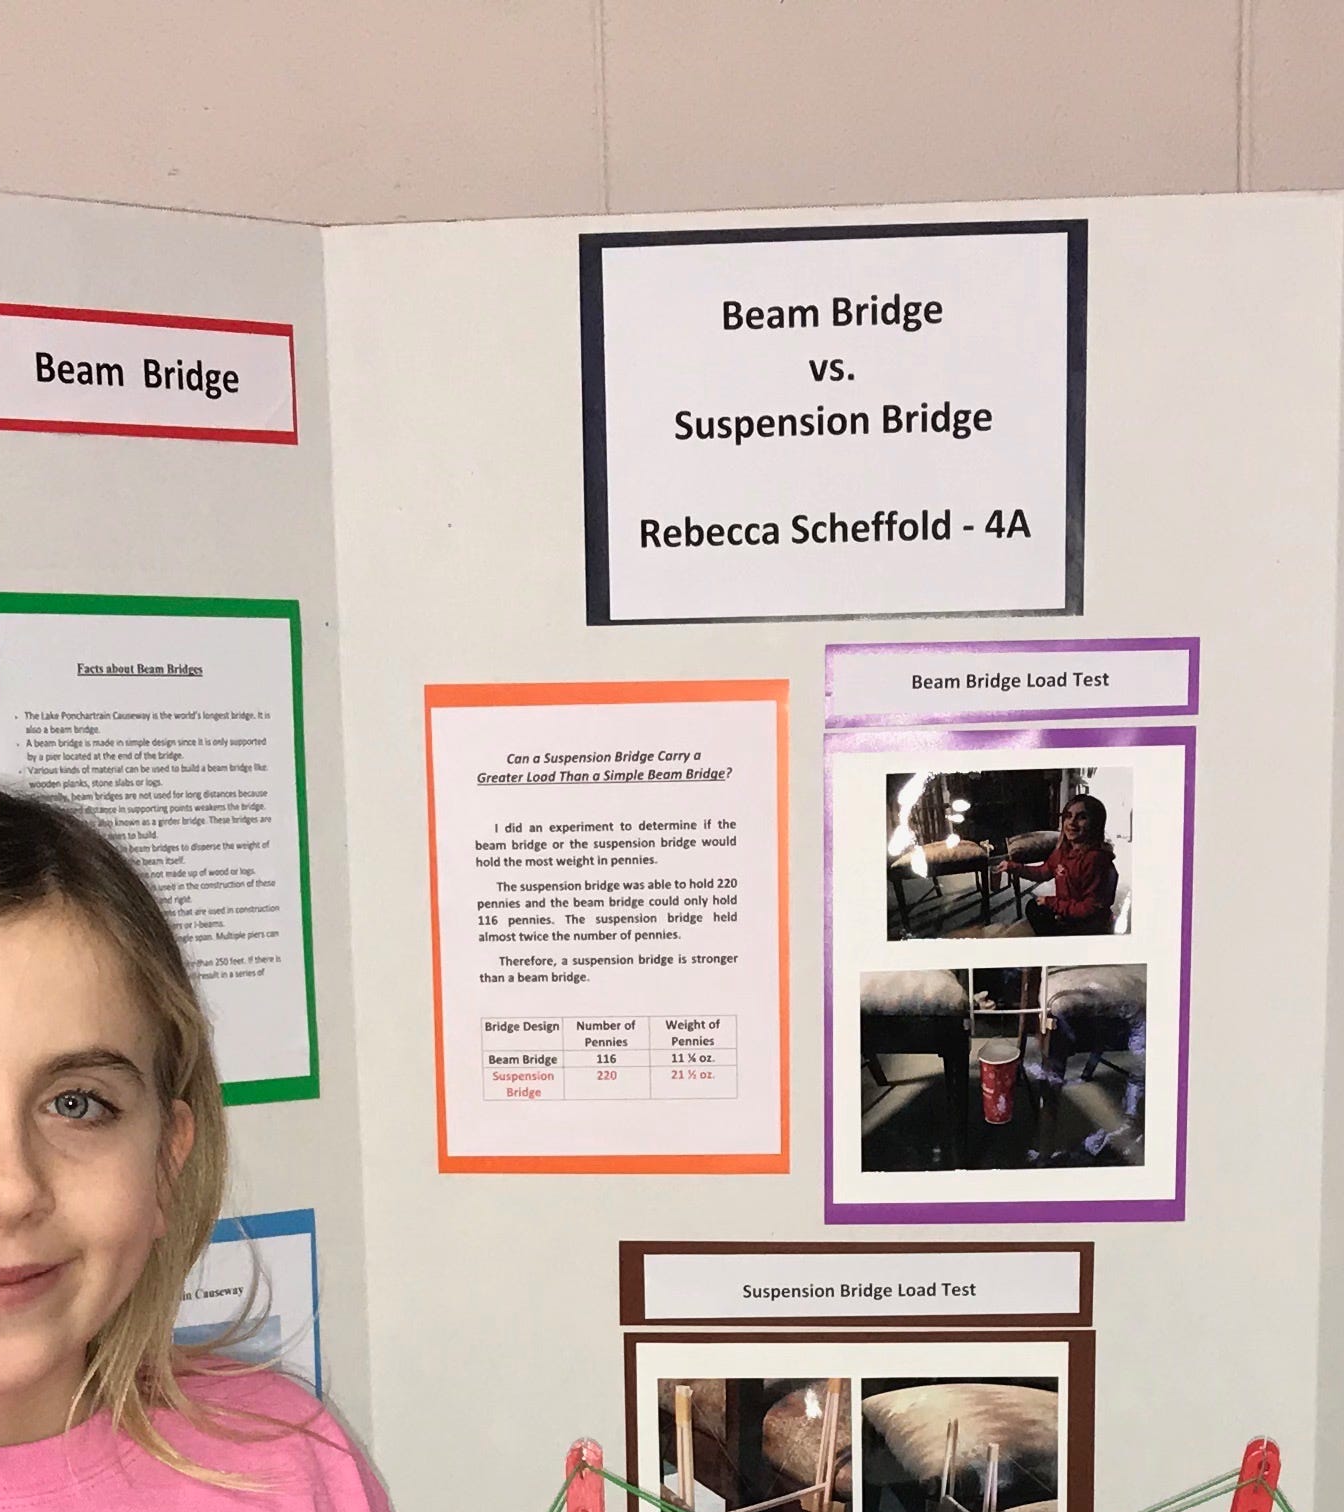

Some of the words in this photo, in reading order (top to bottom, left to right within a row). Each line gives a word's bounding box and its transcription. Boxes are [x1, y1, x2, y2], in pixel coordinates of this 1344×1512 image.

[723, 300, 818, 330] Beam
[832, 293, 942, 331] Bridge
[35, 351, 123, 386] Beam
[143, 358, 238, 399] Bridge
[808, 358, 854, 381] vs.
[675, 405, 868, 445] Suspension
[882, 401, 992, 439] Bridge
[640, 516, 779, 548] Rebecca
[791, 509, 950, 544] Scheffold
[985, 509, 1030, 538] 4A
[77, 663, 103, 674] Facts
[106, 664, 134, 674] about
[137, 664, 164, 674] Beam
[167, 664, 203, 676] Bridges
[912, 674, 959, 689] Beam
[966, 672, 1020, 691] Bridge
[1027, 671, 1066, 687] Load
[1072, 672, 1108, 686] Test
[506, 753, 529, 764] Can
[532, 755, 540, 763] a
[543, 751, 611, 765] Suspension
[614, 750, 654, 764] Bridge
[657, 750, 690, 763] Carry
[693, 752, 701, 760] a
[477, 772, 522, 783] Greater
[527, 772, 556, 782] Load
[560, 771, 588, 782] Than
[593, 774, 600, 782] a
[604, 770, 644, 782] Simple
[648, 769, 682, 780] Beam
[686, 767, 732, 782] Bridge?
[504, 822, 522, 833] did
[529, 824, 542, 832] an
[549, 821, 613, 834] experiment
[619, 822, 632, 831] to
[638, 819, 697, 830] determine
[703, 818, 711, 829] if
[717, 818, 736, 829] the
[475, 840, 506, 850] beam
[511, 839, 547, 852] bridge
[552, 841, 564, 849] or
[569, 838, 588, 848] the
[593, 837, 655, 850] suspension
[660, 836, 696, 849] bridge
[701, 835, 736, 846] would
[475, 856, 500, 867] hold
[503, 856, 522, 866] the
[525, 857, 553, 866] most
[555, 855, 594, 868] weight
[597, 855, 607, 865] in
[610, 855, 657, 867] pennies.
[496, 881, 517, 891] The
[519, 881, 581, 893] suspension
[584, 880, 619, 892] bridge
[622, 881, 644, 889] was
[647, 879, 671, 889] able
[674, 879, 686, 889] to
[689, 878, 713, 888] hold
[717, 878, 737, 888] 220
[478, 915, 498, 925] 116
[508, 914, 554, 927] pennies.
[564, 913, 585, 924] The
[595, 912, 657, 925] suspension
[667, 911, 702, 924] bridge
[713, 911, 737, 921] held
[499, 955, 556, 966] Therefore,
[561, 957, 567, 965] a
[572, 954, 633, 967] suspension
[638, 953, 673, 966] bridge
[678, 953, 687, 963] is
[691, 954, 738, 965] stronger
[484, 1021, 519, 1033] Bridge
[522, 1020, 559, 1033] Design
[576, 1020, 620, 1030] Number
[624, 1019, 635, 1030] of
[665, 1019, 705, 1031] Weight
[708, 1018, 720, 1029] of
[584, 1036, 627, 1046] Pennies
[671, 1035, 714, 1046] Pennies
[488, 1054, 519, 1064] Beam
[522, 1054, 557, 1066] Bridge
[597, 1053, 616, 1063] 116
[671, 1053, 683, 1063] 11
[492, 1071, 554, 1082] Suspension
[597, 1070, 617, 1080] 220
[671, 1069, 683, 1079] 21
[506, 1086, 541, 1099] Bridge
[743, 1283, 834, 1301] Suspension
[840, 1283, 892, 1300] Bridge
[898, 1282, 935, 1296] Load
[941, 1282, 975, 1296] Test
